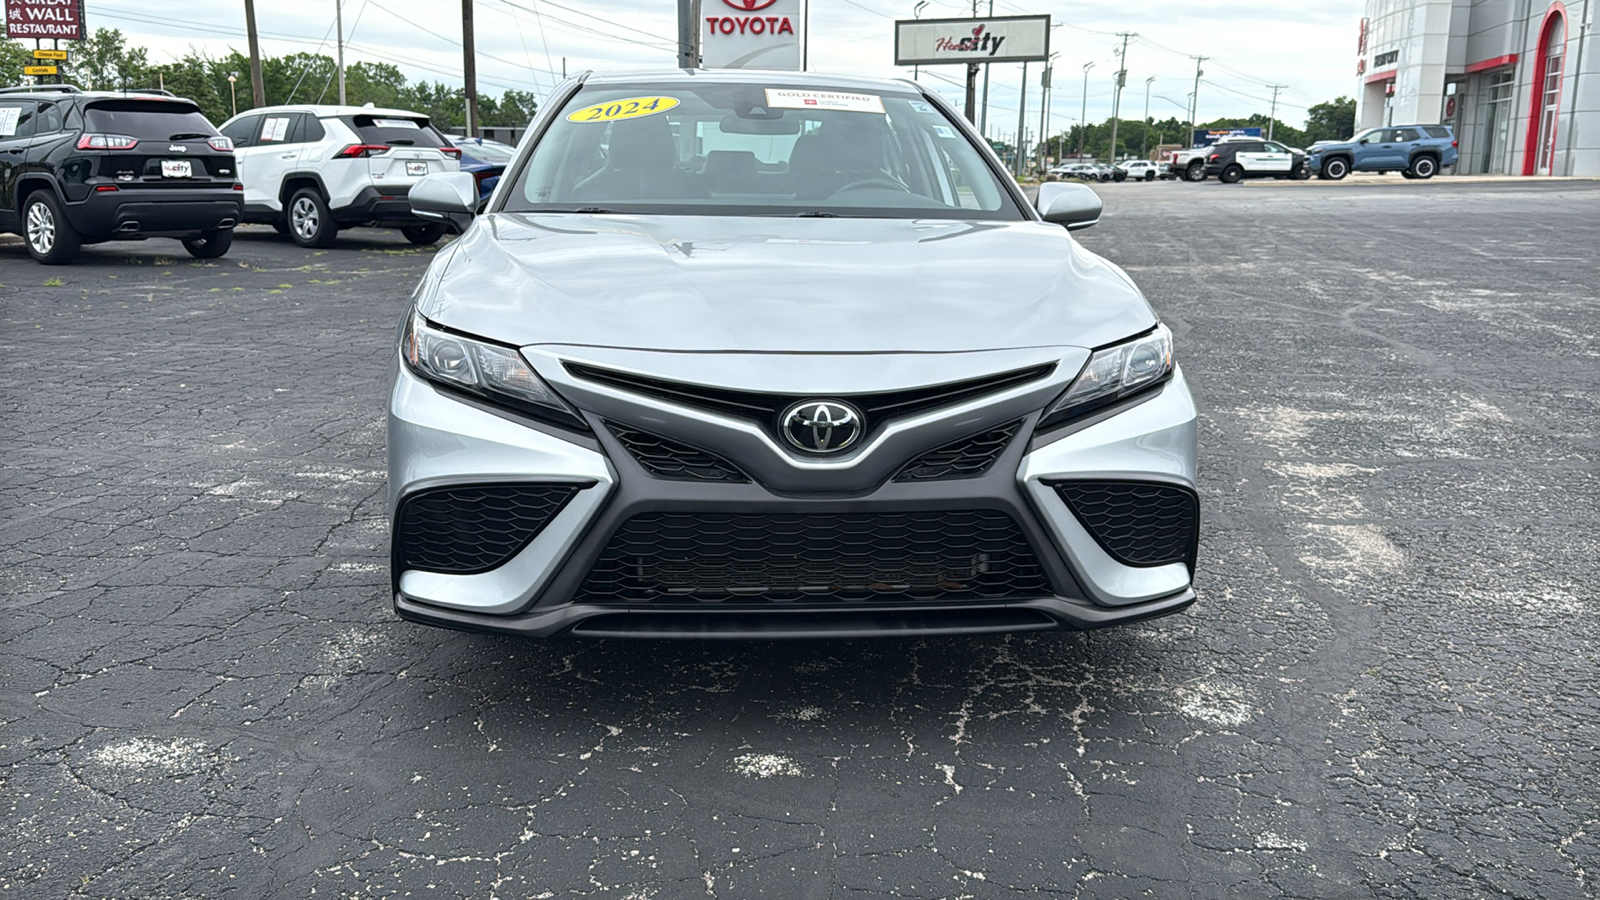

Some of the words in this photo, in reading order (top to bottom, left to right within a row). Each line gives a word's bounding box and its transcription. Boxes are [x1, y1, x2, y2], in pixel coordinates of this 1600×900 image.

[25, 7, 74, 21] WALL
[9, 23, 78, 35] RESTAURANT
[706, 16, 794, 35] TOYOTA
[813, 93, 871, 102] CERTIFIED
[585, 98, 661, 121] 2024
[168, 144, 187, 152] Jeep
